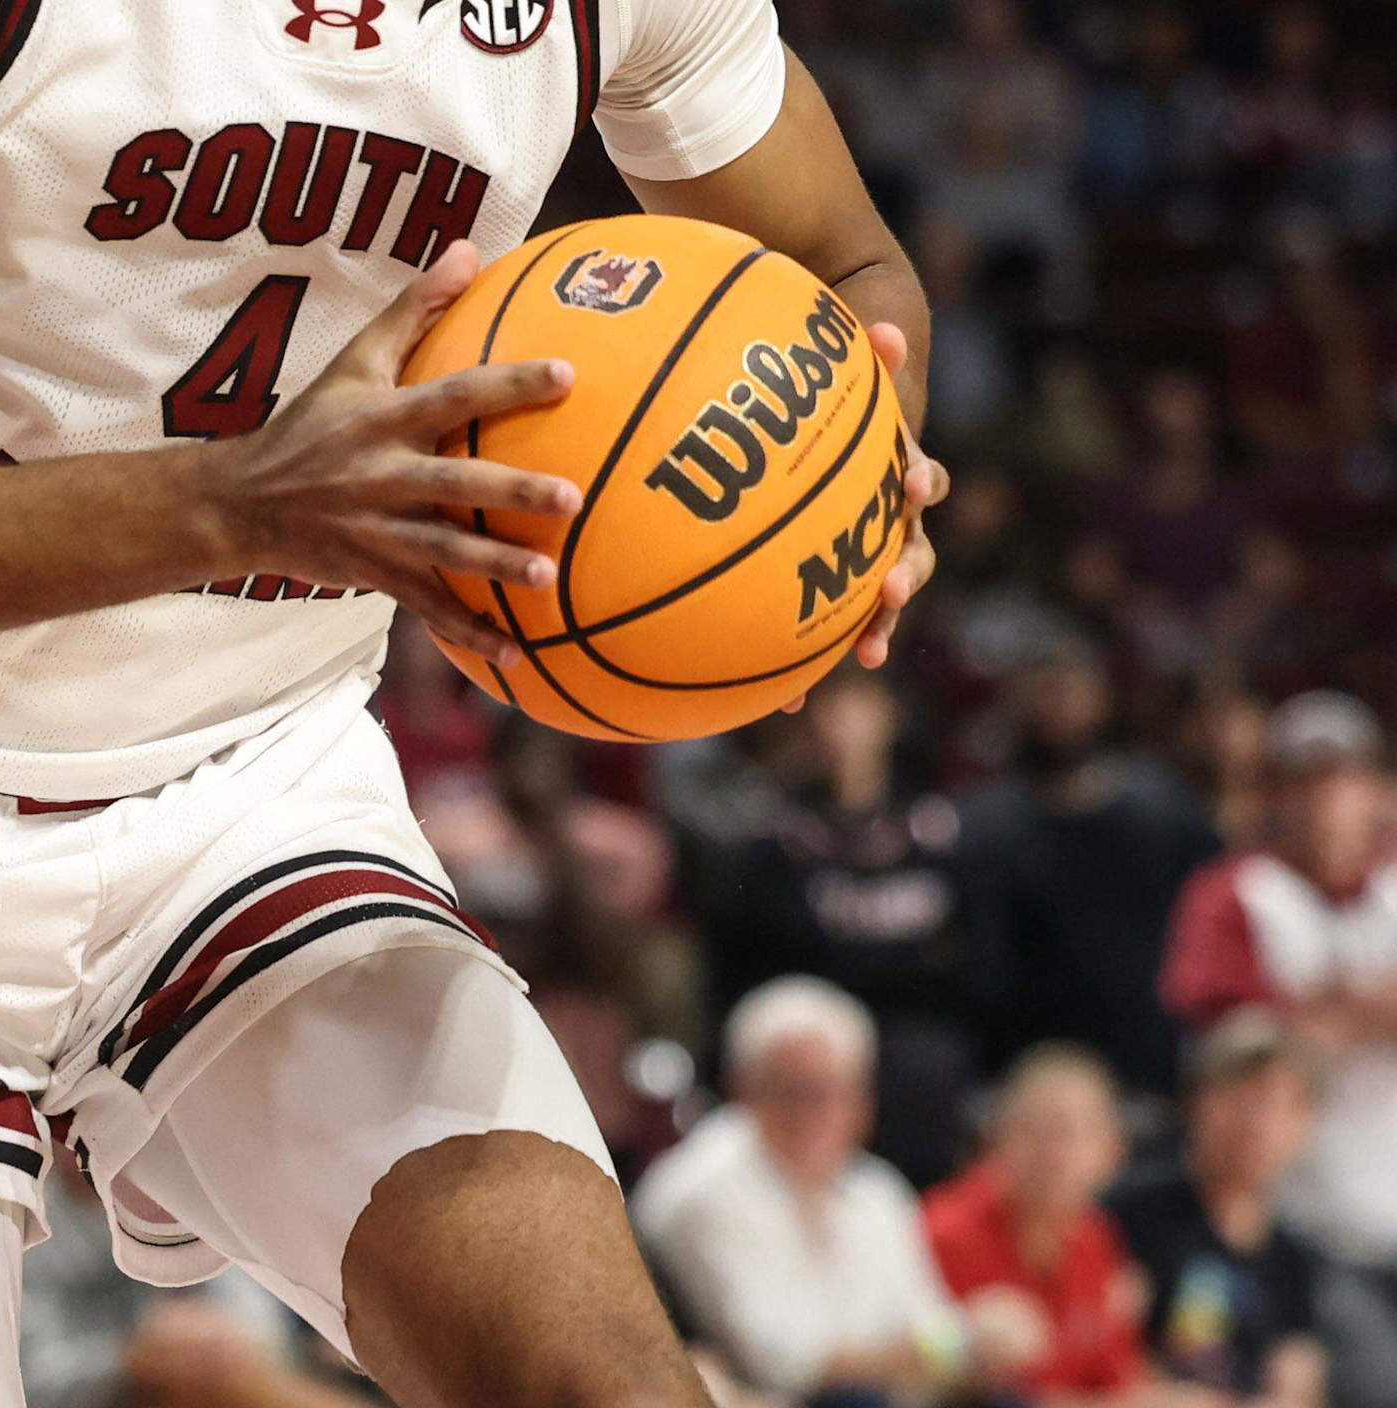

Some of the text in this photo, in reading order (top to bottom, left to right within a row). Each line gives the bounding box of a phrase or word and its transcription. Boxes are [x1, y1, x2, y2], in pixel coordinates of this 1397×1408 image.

[83, 121, 491, 272] SOUTH
[162, 274, 311, 442] 4
[644, 289, 858, 523] Wilson
